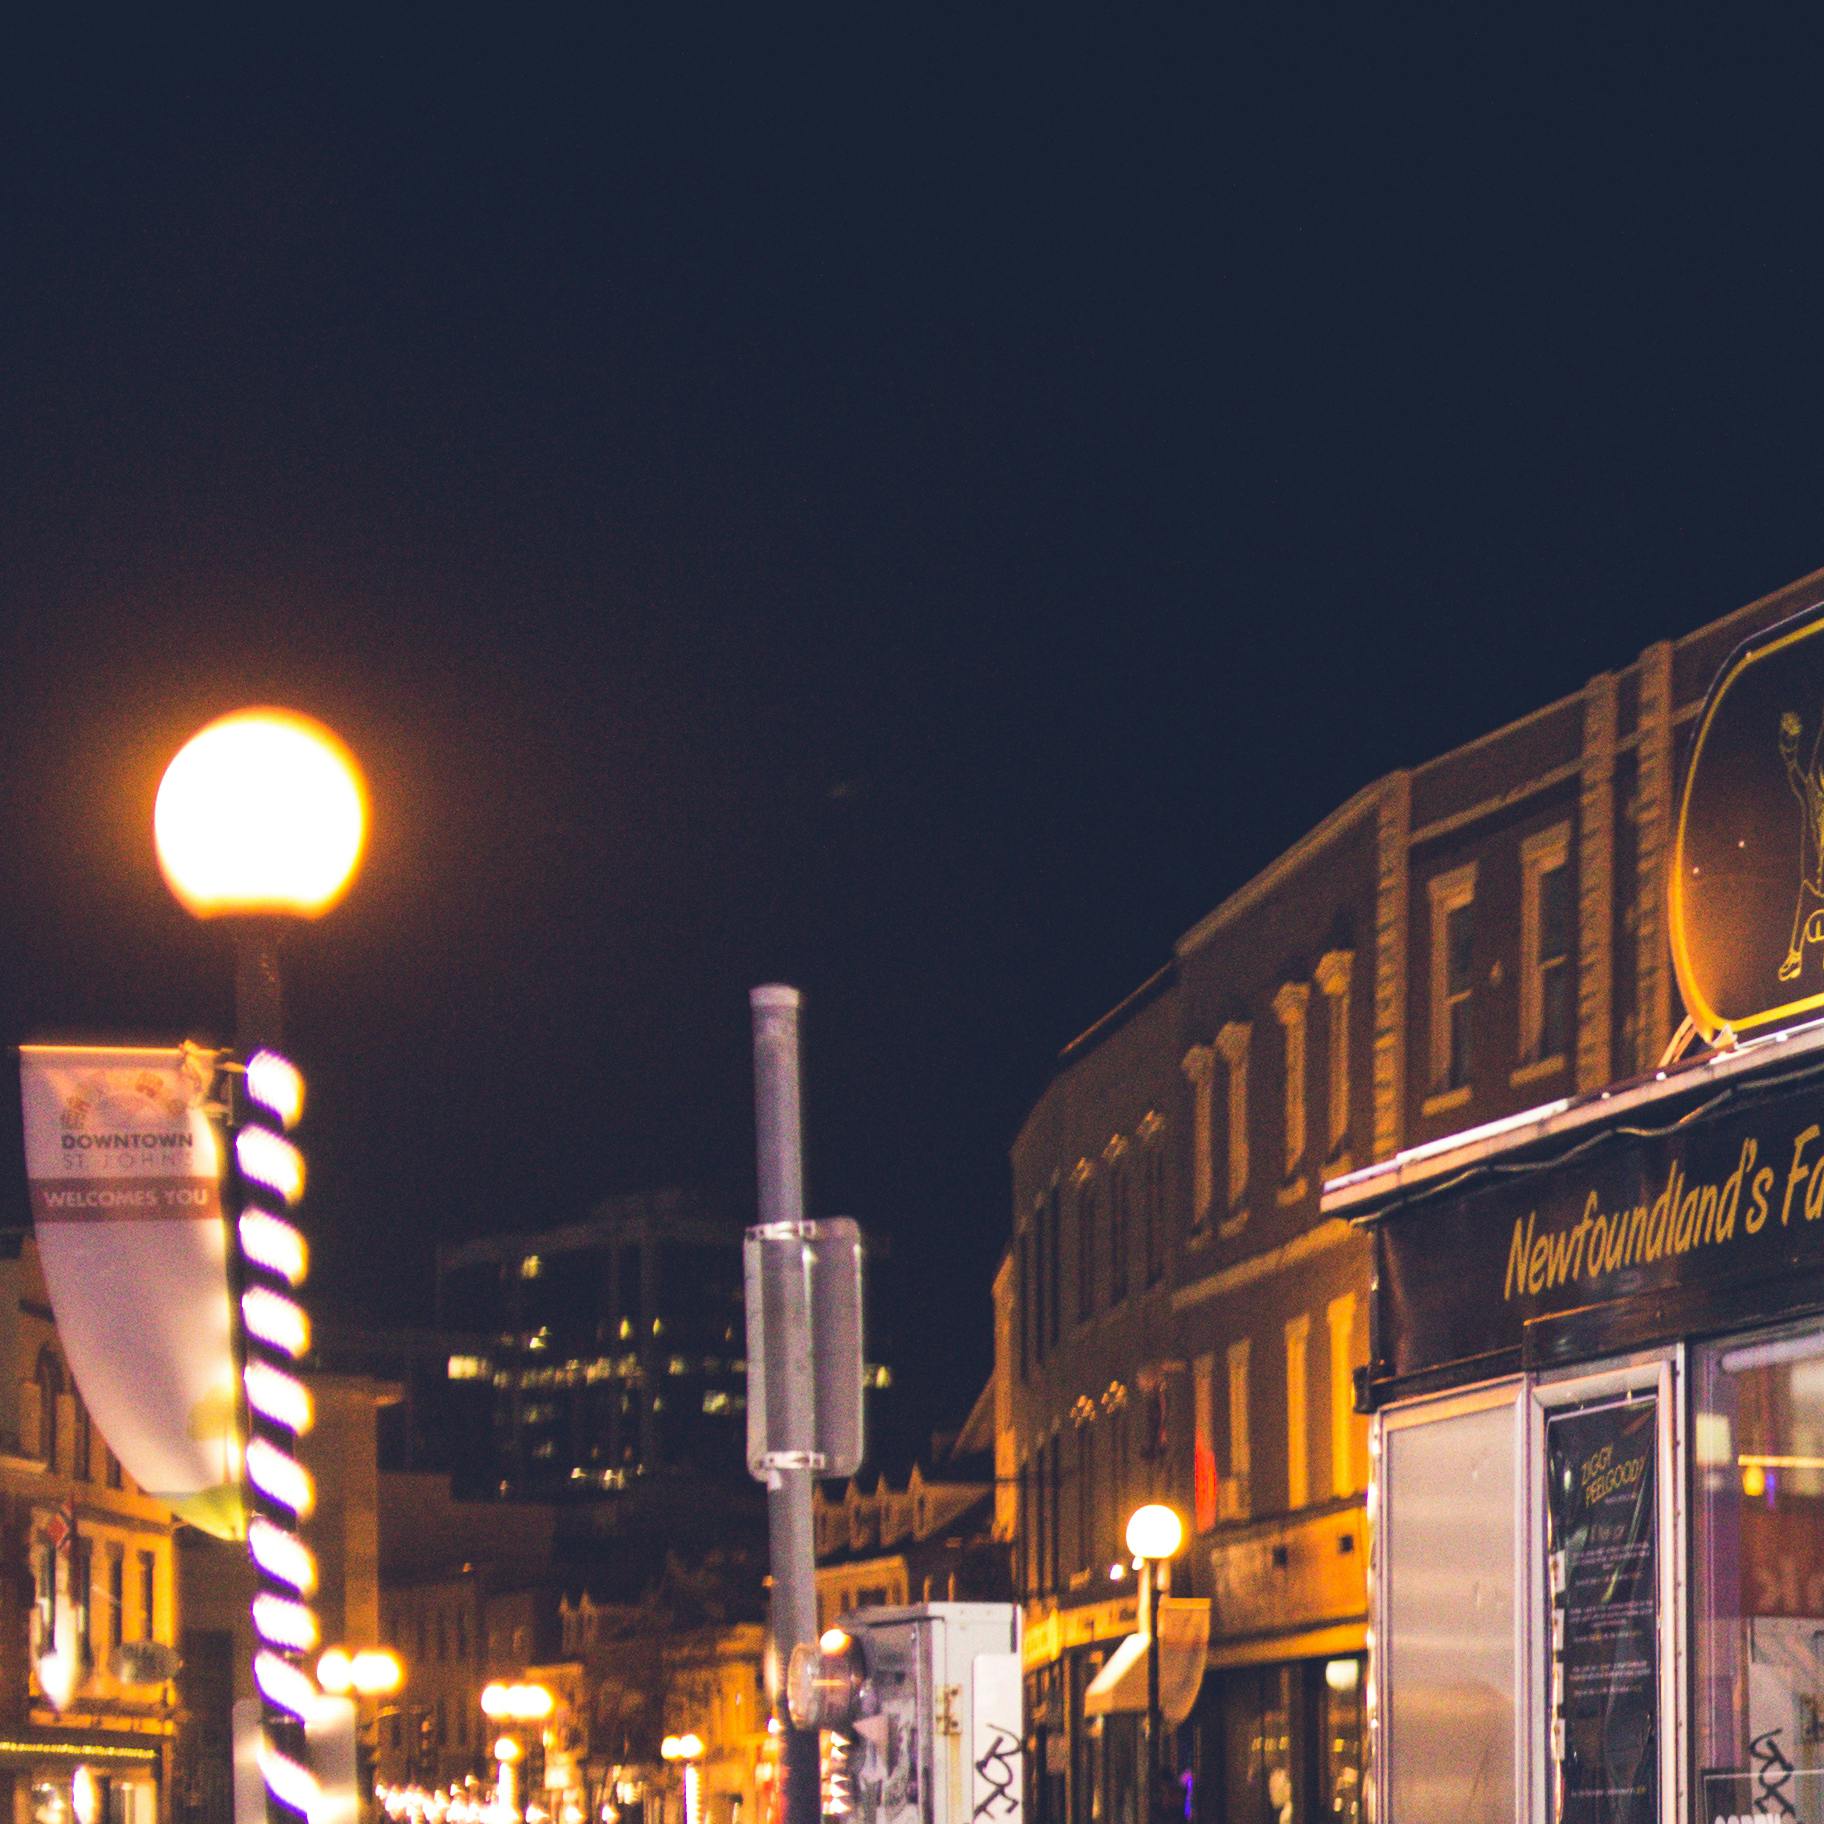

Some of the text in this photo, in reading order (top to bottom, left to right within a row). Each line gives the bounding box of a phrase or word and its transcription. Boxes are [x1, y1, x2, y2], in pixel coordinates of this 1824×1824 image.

[61, 1132, 194, 1150] DOWNTOWN
[101, 1152, 193, 1169] JOHNS
[44, 1187, 208, 1208] WELCOMES YOU
[1505, 1138, 1773, 1300] Newfoundland's
